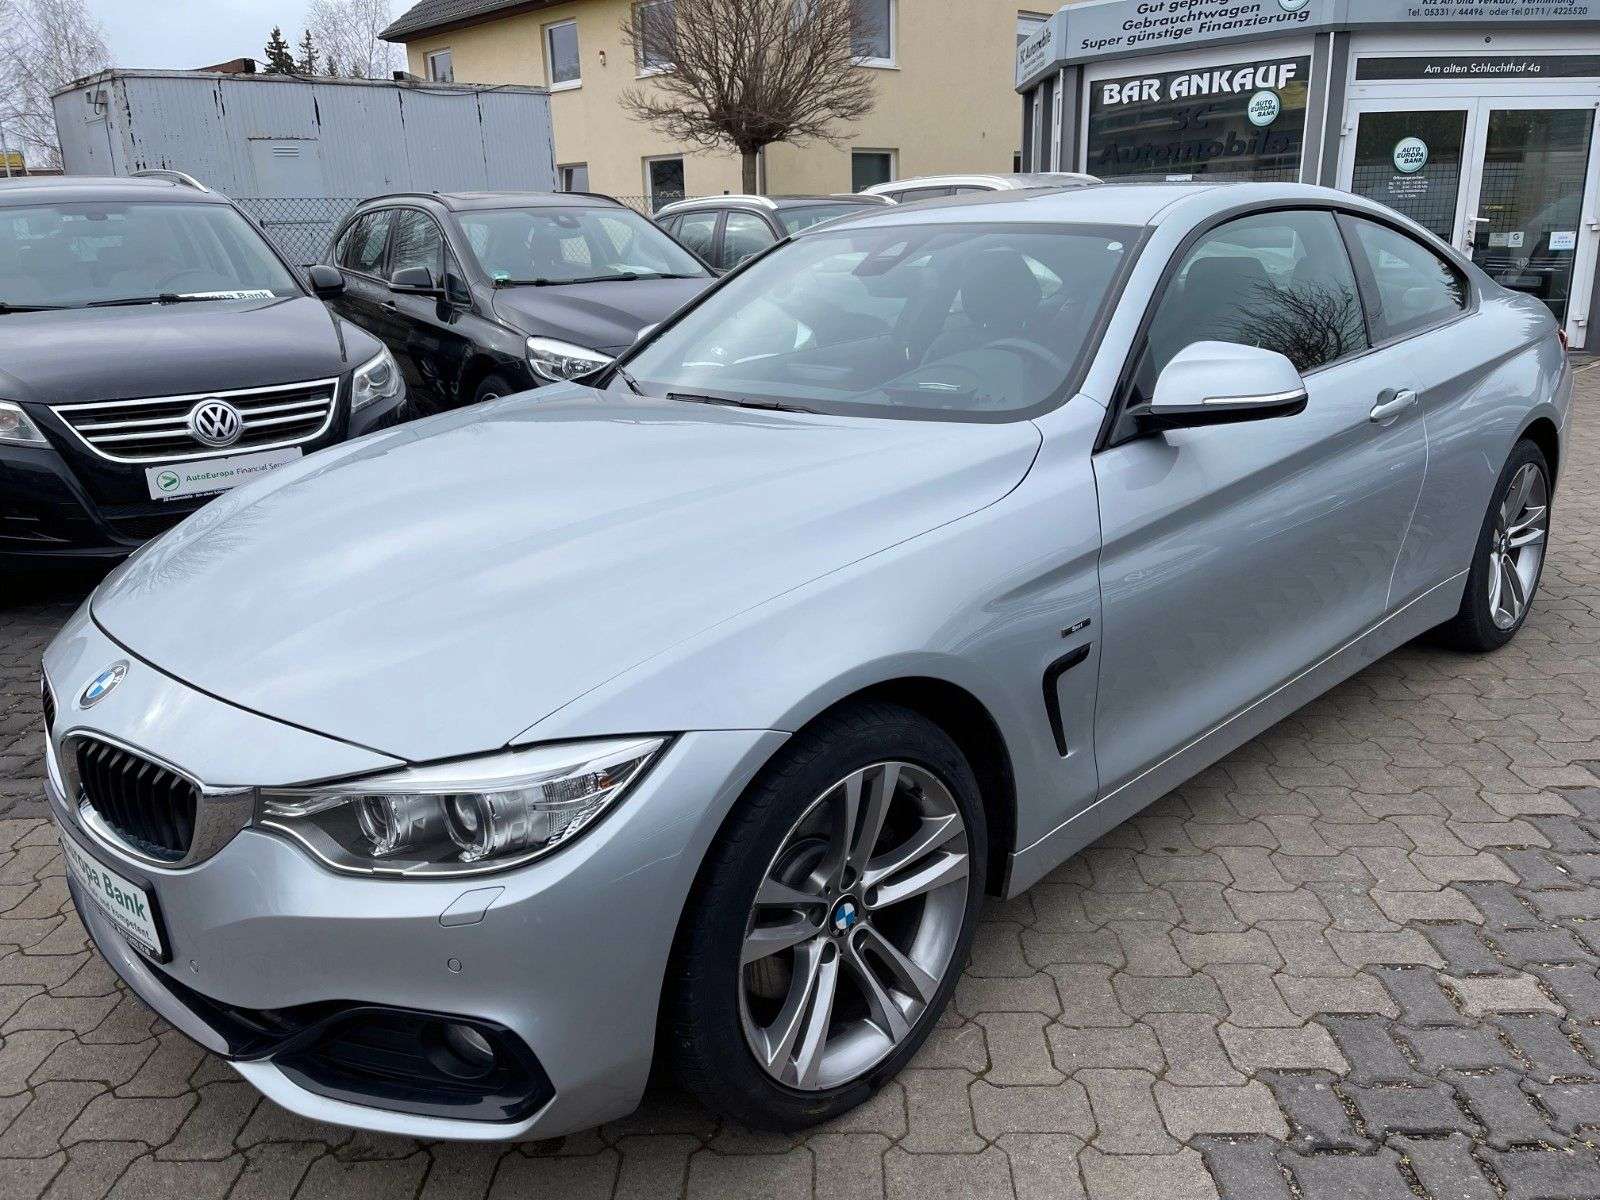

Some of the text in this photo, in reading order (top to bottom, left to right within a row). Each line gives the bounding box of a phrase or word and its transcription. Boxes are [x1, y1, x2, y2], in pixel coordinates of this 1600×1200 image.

[1122, 3, 1261, 31] Gebrauchtwagen
[1137, 2, 1165, 14] Gut
[1408, 8, 1422, 16] Tel.
[1424, 8, 1449, 16] 05331
[1458, 8, 1484, 16] 44496
[1489, 8, 1508, 16] oder
[1081, 10, 1310, 50] Super günstige Finanzierung
[1424, 62, 1541, 73] Am alten Schlachthof 4a
[1103, 63, 1297, 105] BAR ANKAUF
[237, 291, 270, 299] Bank
[186, 470, 234, 482] AutoEuropa
[236, 464, 267, 475] Financial
[102, 872, 147, 921] Bank
